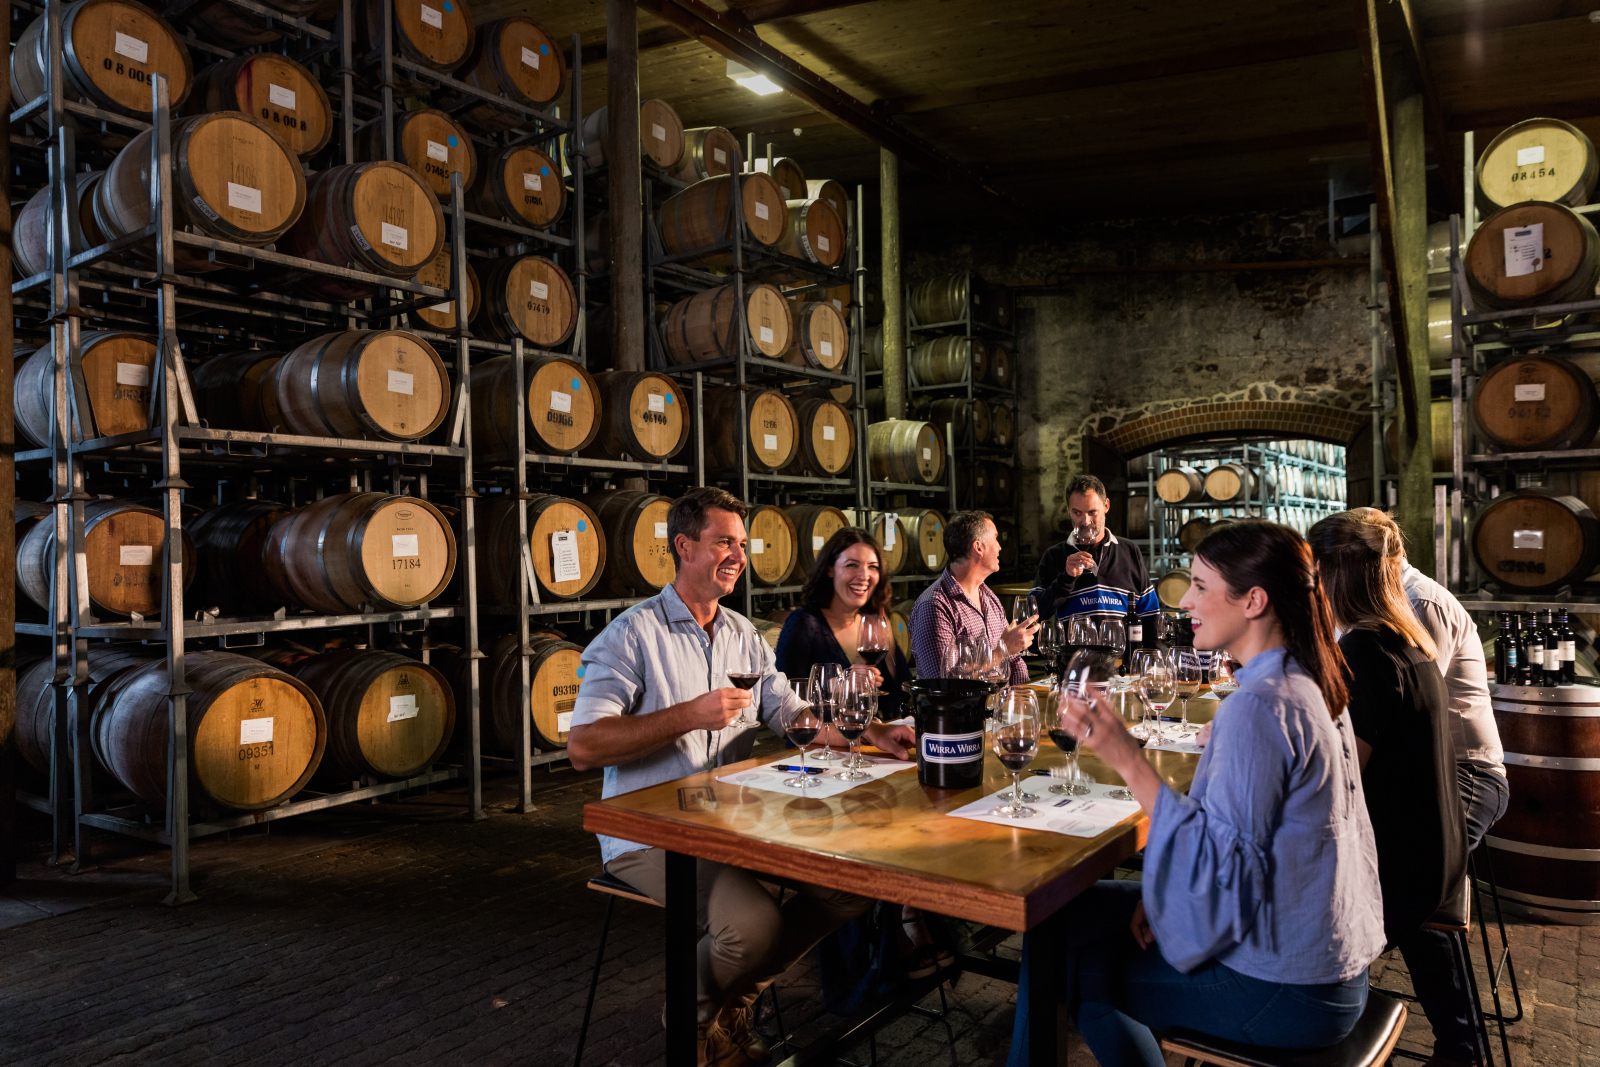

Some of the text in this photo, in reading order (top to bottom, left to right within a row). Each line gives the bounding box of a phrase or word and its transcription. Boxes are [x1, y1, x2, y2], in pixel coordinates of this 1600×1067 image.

[1511, 167, 1556, 182] 08454
[392, 558, 421, 570] 17184
[1080, 595, 1123, 606] WIRRA WIRRA
[238, 743, 274, 761] 09351
[928, 742, 981, 754] WIRRA WIRRA
